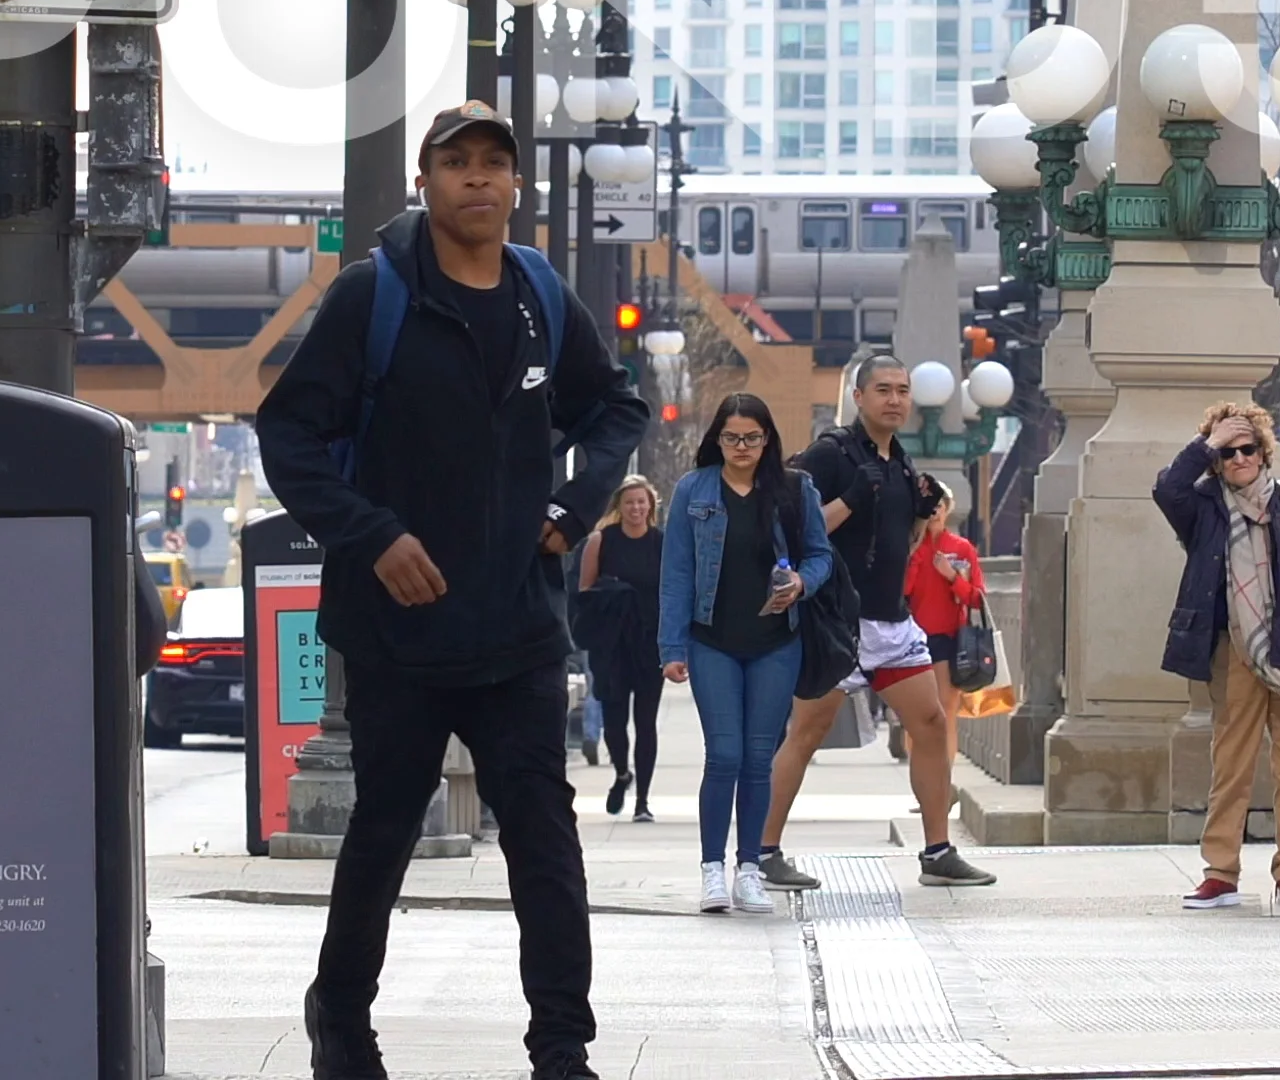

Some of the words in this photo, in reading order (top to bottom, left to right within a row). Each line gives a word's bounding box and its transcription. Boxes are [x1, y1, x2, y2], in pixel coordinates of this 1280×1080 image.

[4, 5, 49, 14] CHICAGO
[594, 192, 629, 202] EHICLE
[8, 895, 30, 907] unit
[33, 896, 45, 907] at
